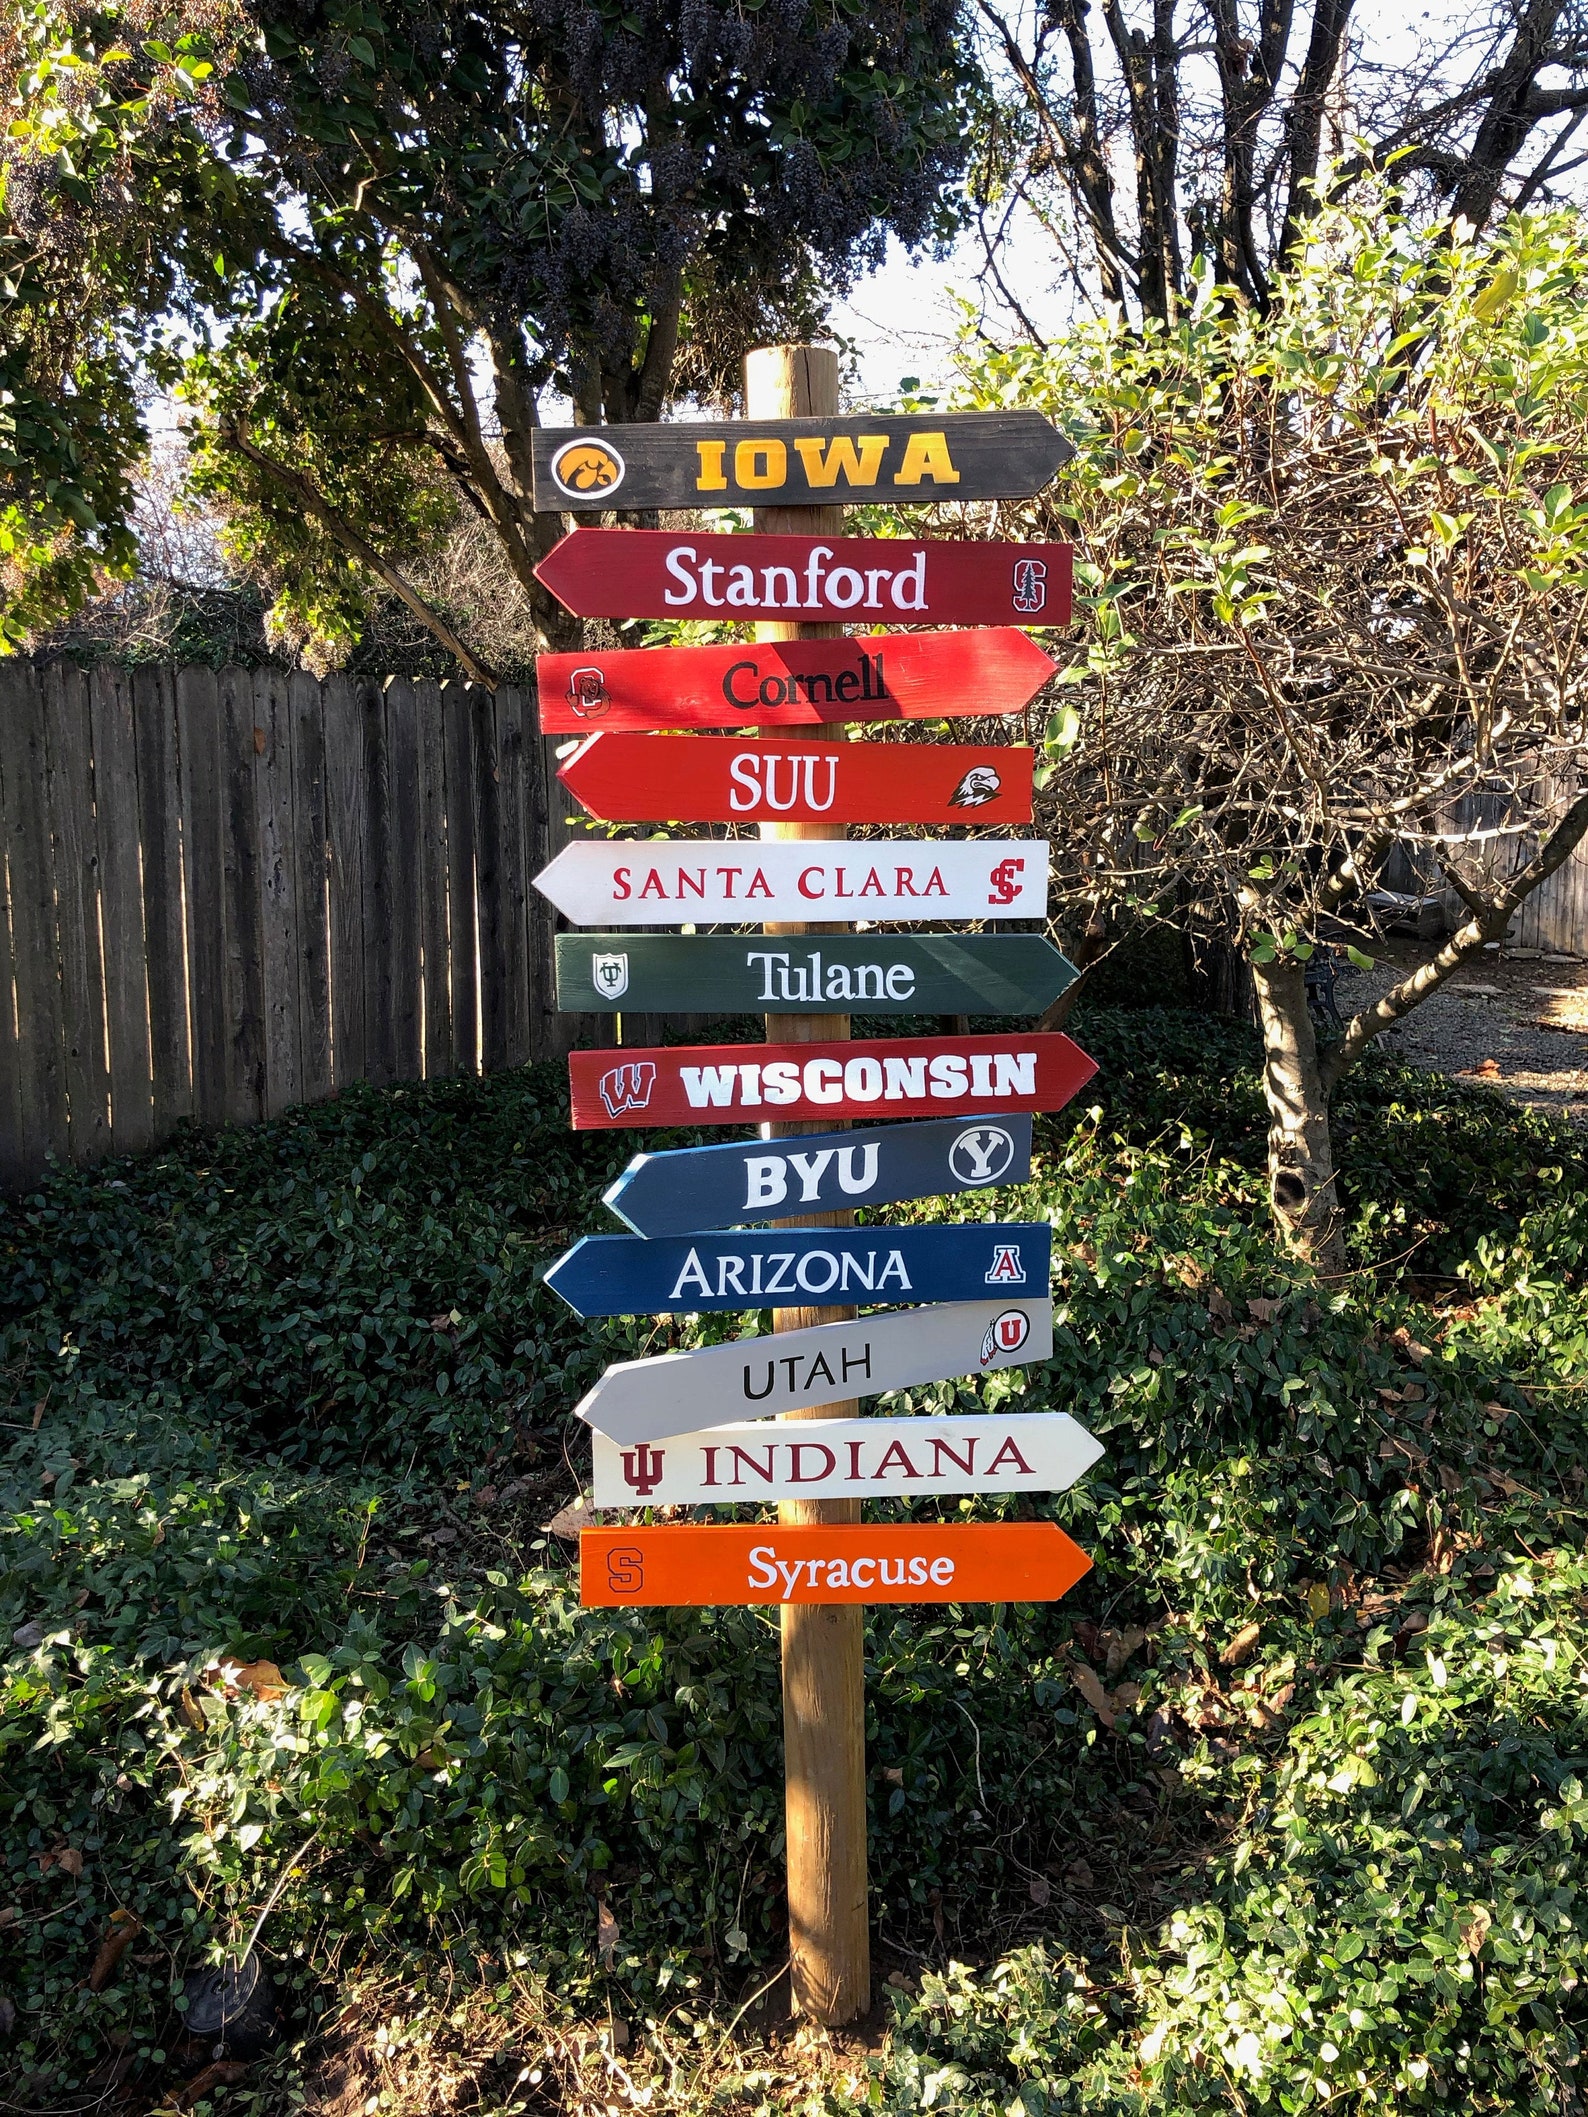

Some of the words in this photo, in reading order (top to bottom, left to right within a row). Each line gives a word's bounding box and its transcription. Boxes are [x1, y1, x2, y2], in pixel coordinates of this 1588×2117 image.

[696, 432, 960, 491] IOWA
[664, 546, 929, 610] Stanford
[722, 653, 891, 710] Cornell
[730, 752, 839, 811] SUU
[613, 867, 775, 901] SANTA
[797, 866, 951, 900] CLARA
[747, 951, 916, 1002] Tulane
[600, 1061, 656, 1119] W
[679, 1052, 1037, 1108] WISCONSIN
[742, 1142, 881, 1210] BYU
[958, 1130, 1005, 1178] Y
[668, 1246, 912, 1299] ARIZONA
[984, 1245, 1027, 1285] A
[1000, 1318, 1022, 1347] U
[742, 1343, 871, 1400] UTAH
[700, 1435, 1036, 1487] INDIANA
[606, 1547, 644, 1593] S
[747, 1545, 955, 1599] Syracuse
